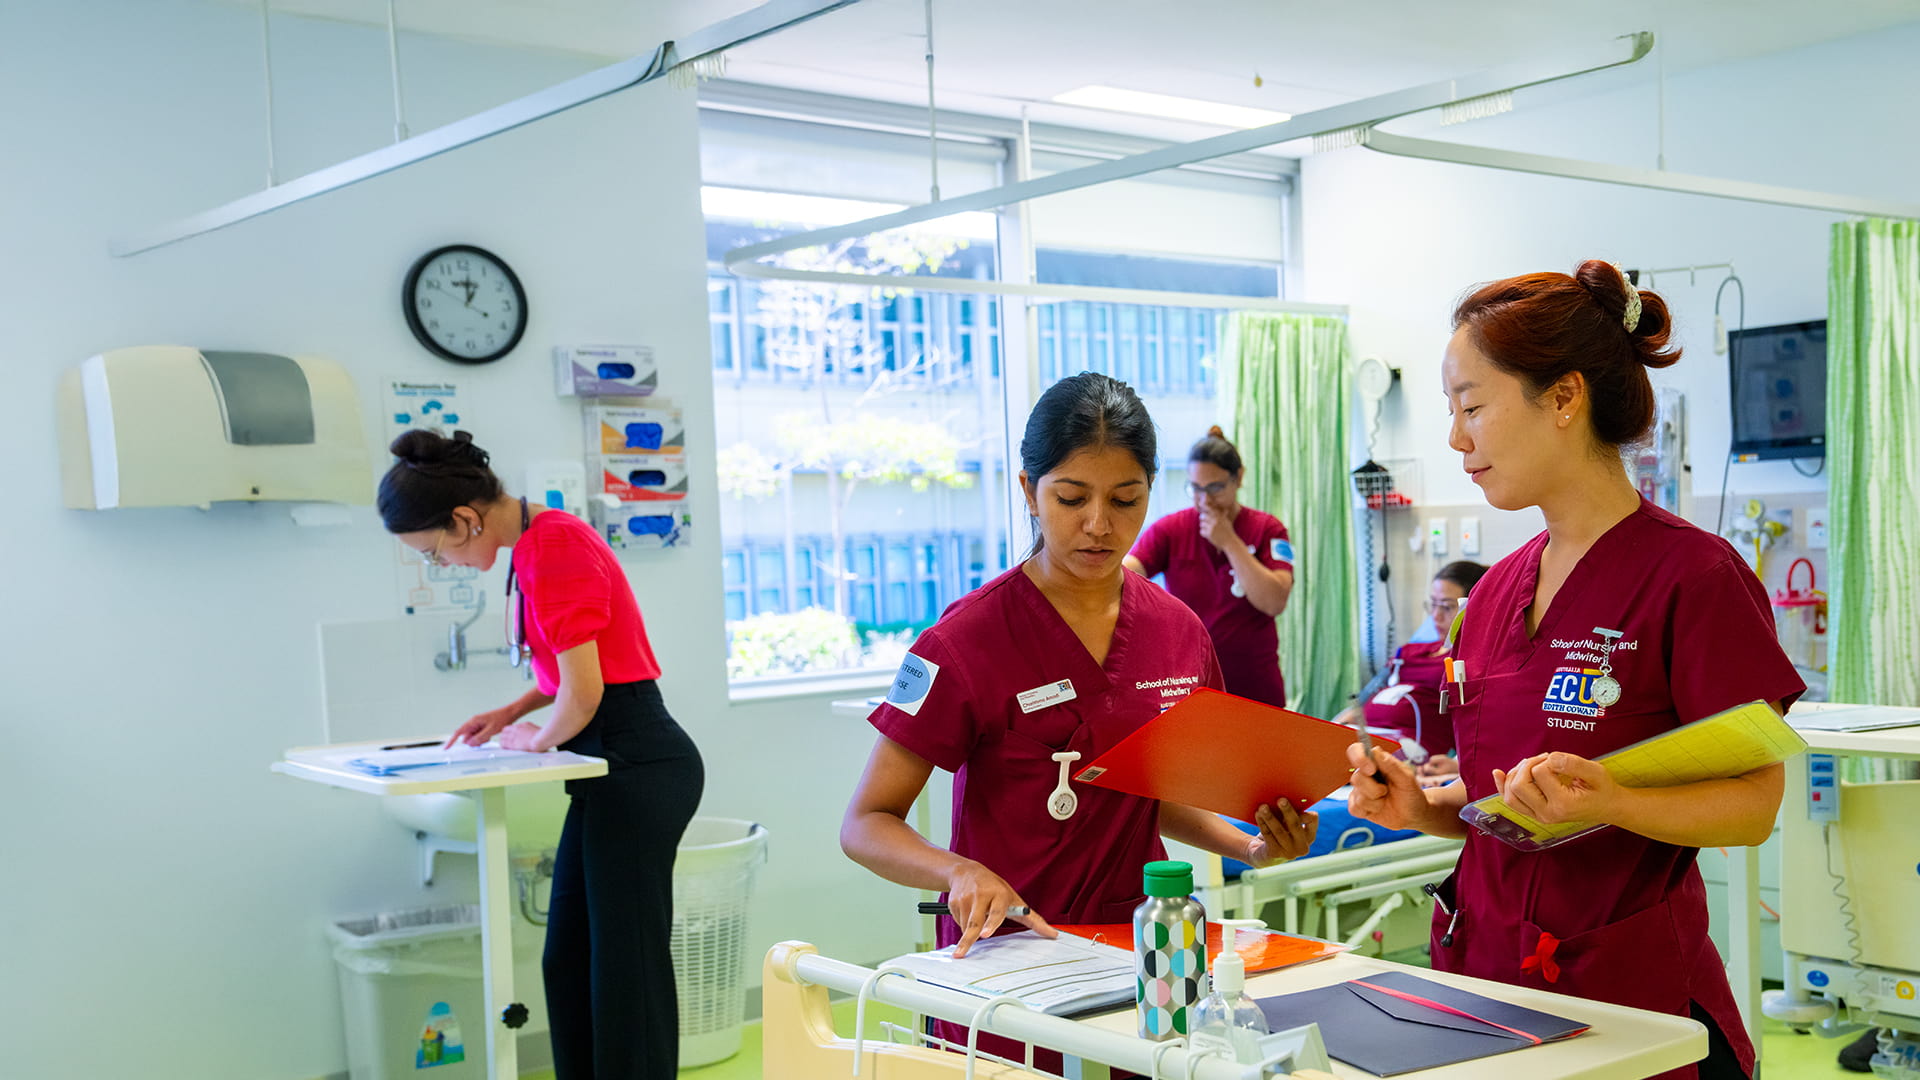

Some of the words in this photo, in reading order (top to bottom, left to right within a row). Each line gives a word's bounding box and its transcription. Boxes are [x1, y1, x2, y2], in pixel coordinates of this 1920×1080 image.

[440, 263, 452, 276] 11
[502, 299, 512, 313] 3
[1550, 638, 1574, 649] School
[1574, 640, 1584, 649] of
[1618, 640, 1638, 650] and
[1136, 679, 1162, 690] School
[1162, 677, 1170, 687] of
[1545, 674, 1597, 704] ECU
[1160, 687, 1191, 698] Midwifery
[1543, 703, 1566, 712] EDITH
[1566, 705, 1596, 716] COWAN
[1547, 717, 1597, 732] STUDENT
